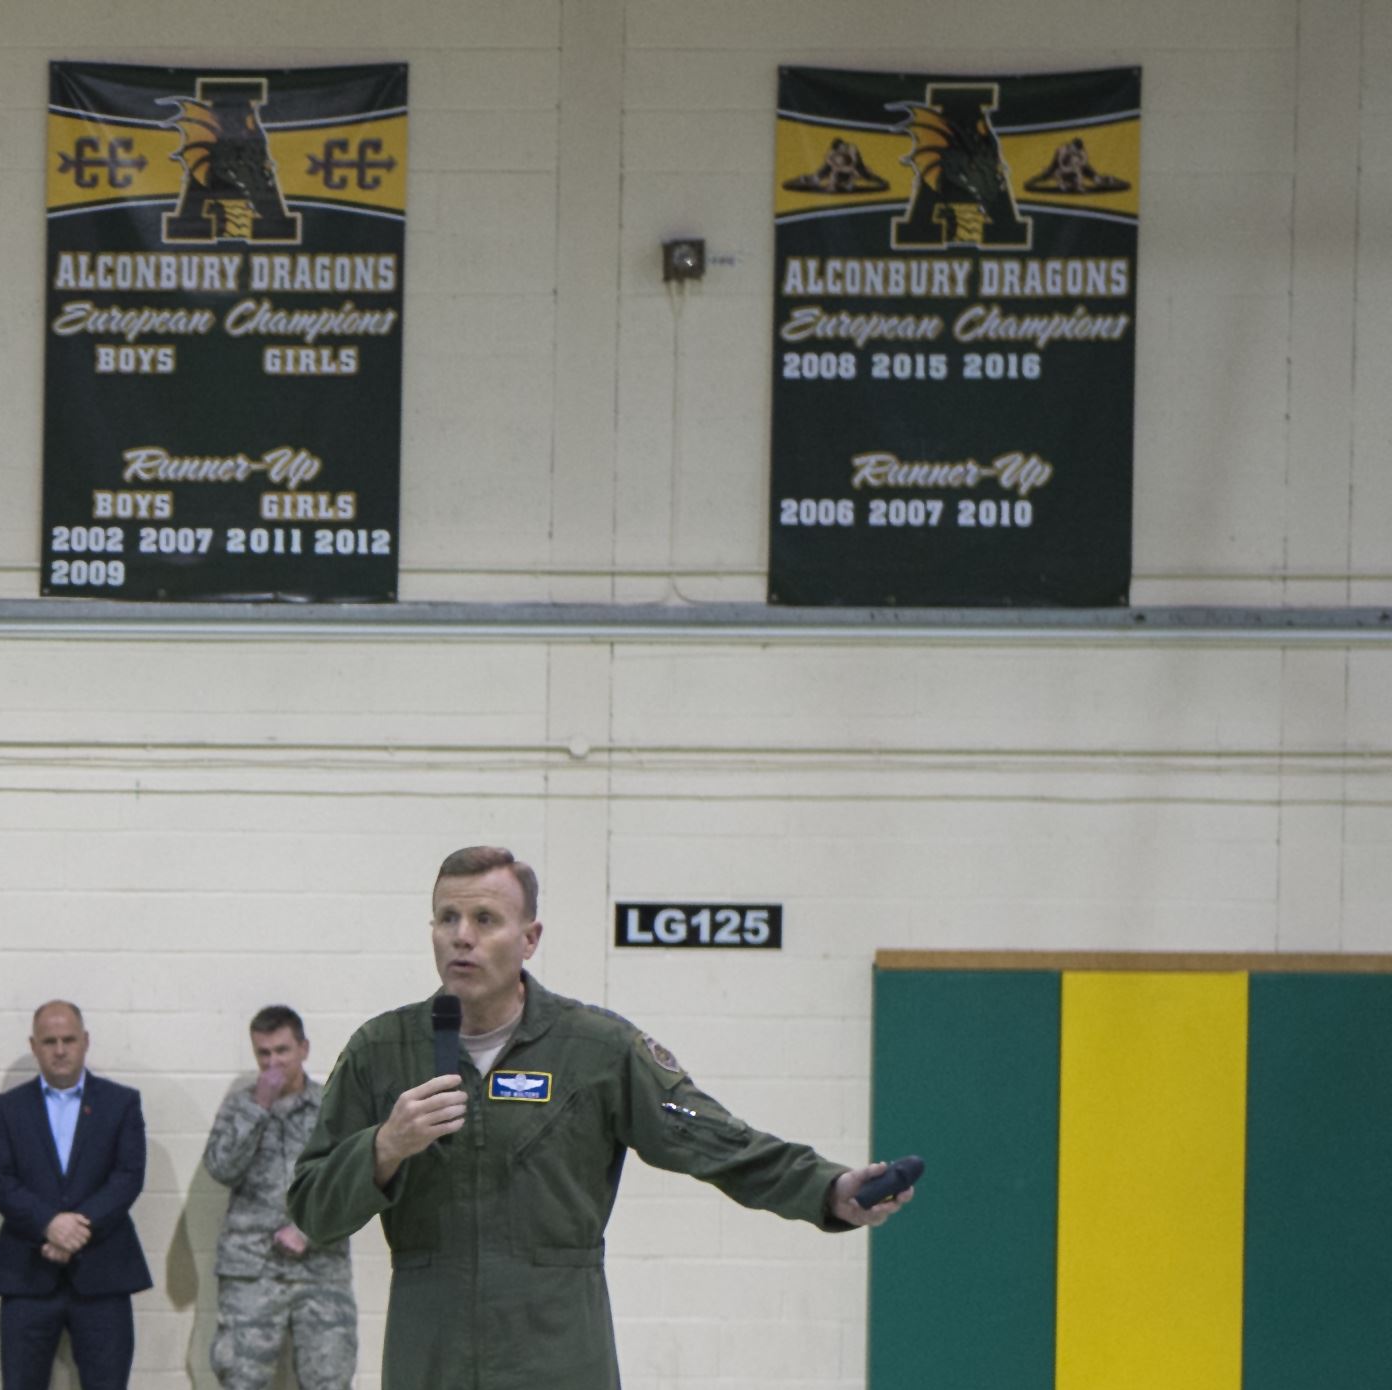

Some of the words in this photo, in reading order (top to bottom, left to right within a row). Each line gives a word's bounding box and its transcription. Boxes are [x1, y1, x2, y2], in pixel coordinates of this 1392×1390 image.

[54, 252, 242, 292] ALCONBURY
[250, 254, 397, 292] DRAGONS
[782, 257, 971, 297] ALCONBURY
[979, 258, 1130, 298] DRAGONS
[52, 300, 216, 344] European
[224, 299, 398, 345] Champions
[780, 305, 944, 349] European
[952, 304, 1130, 350] Champions
[95, 344, 176, 374] BOYS
[263, 346, 359, 375] GIRLS
[783, 352, 857, 379] 2008
[872, 353, 947, 379] 2015
[963, 353, 1041, 380] 2016
[123, 447, 322, 491] Runner-Up
[851, 452, 1053, 497] Runner-Up
[93, 490, 173, 519] BOYS
[260, 492, 356, 520] GIRLS
[780, 499, 854, 526] 2006
[869, 499, 943, 527] 2007
[957, 500, 1033, 527] 2010
[52, 526, 124, 552] 2002
[139, 527, 214, 553] 2007
[226, 528, 302, 554] 2011
[314, 529, 391, 555] 2012
[51, 560, 125, 586] 2009
[626, 908, 770, 944] LG125
